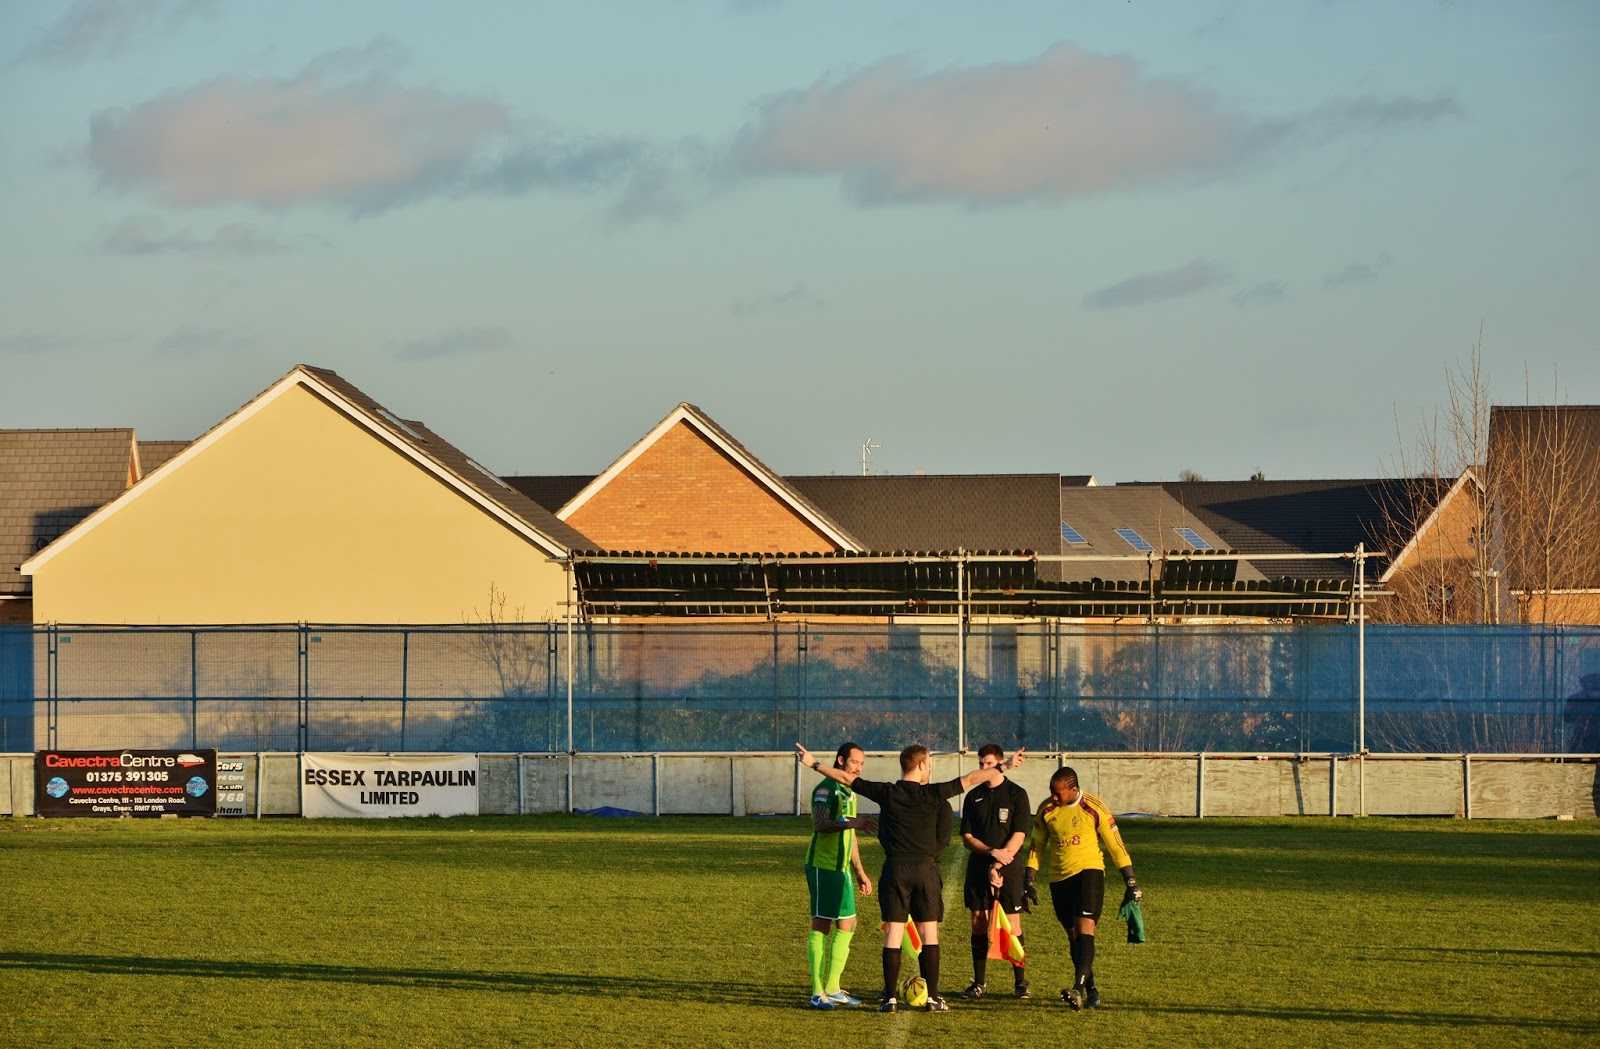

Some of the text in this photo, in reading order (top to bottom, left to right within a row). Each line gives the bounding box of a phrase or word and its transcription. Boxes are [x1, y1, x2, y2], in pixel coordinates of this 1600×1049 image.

[45, 754, 175, 767] CavectraCentre
[86, 771, 169, 782] 01375 391305
[305, 769, 476, 786] ESSEX TARPAULIN
[72, 785, 184, 794] www.cavectracentre.com
[98, 797, 120, 805] Centre,
[168, 797, 186, 805] Road,
[360, 791, 419, 805] LIMITED
[92, 805, 112, 813] Grays,
